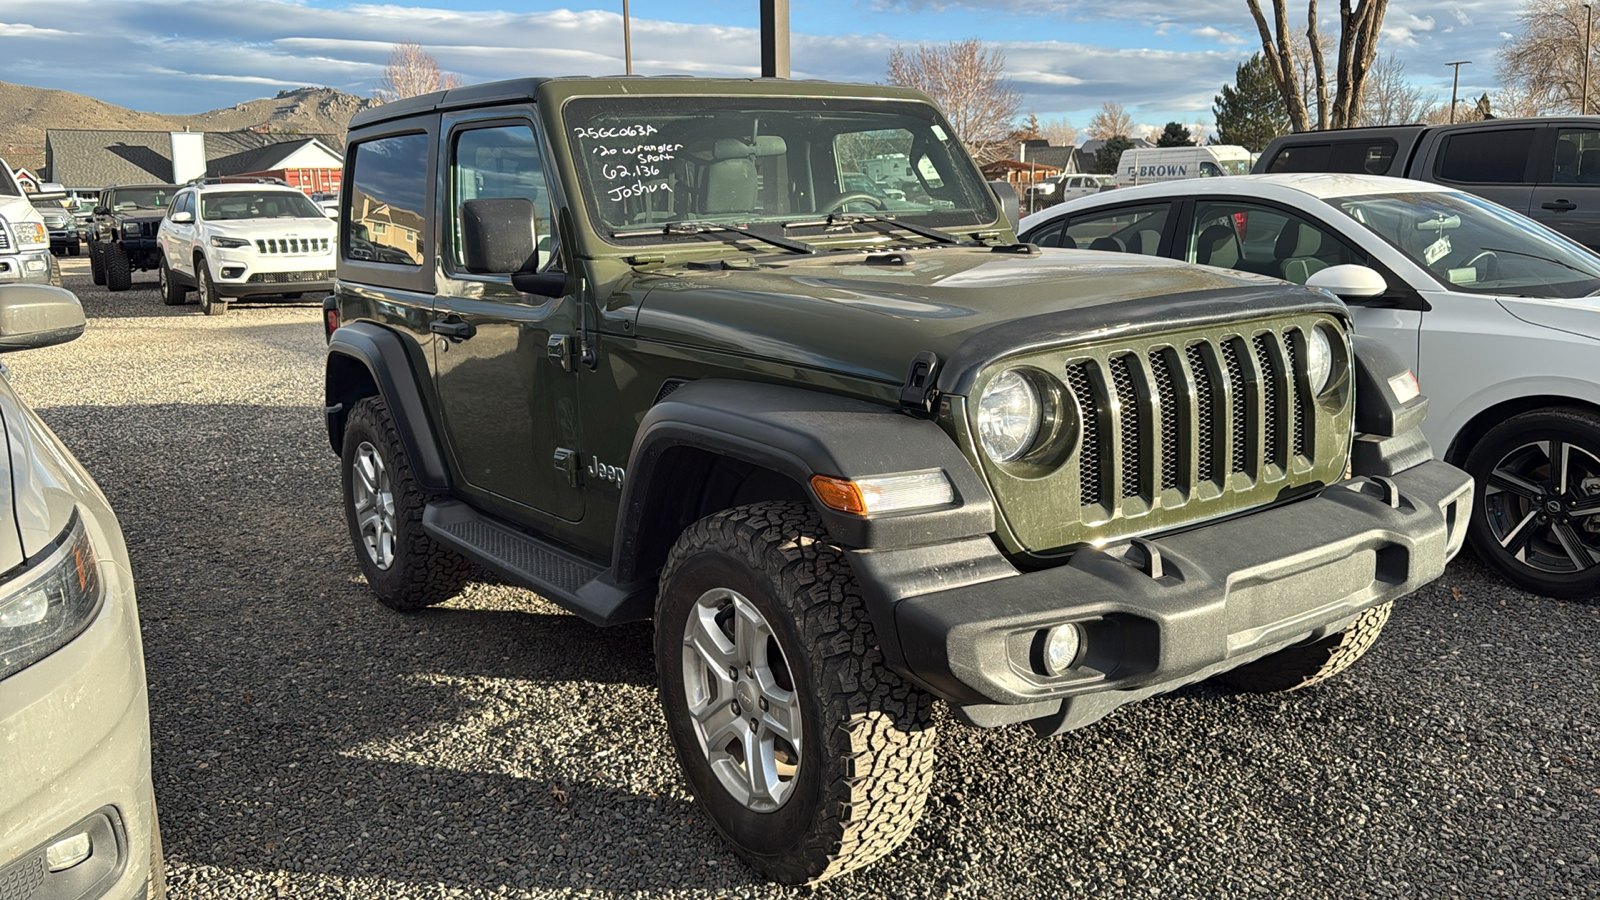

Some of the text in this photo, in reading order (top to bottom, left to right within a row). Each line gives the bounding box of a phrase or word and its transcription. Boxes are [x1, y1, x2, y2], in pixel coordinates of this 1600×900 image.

[1140, 165, 1187, 177] BROWN
[607, 180, 673, 201] Joshua
[587, 455, 626, 489] Jeep
